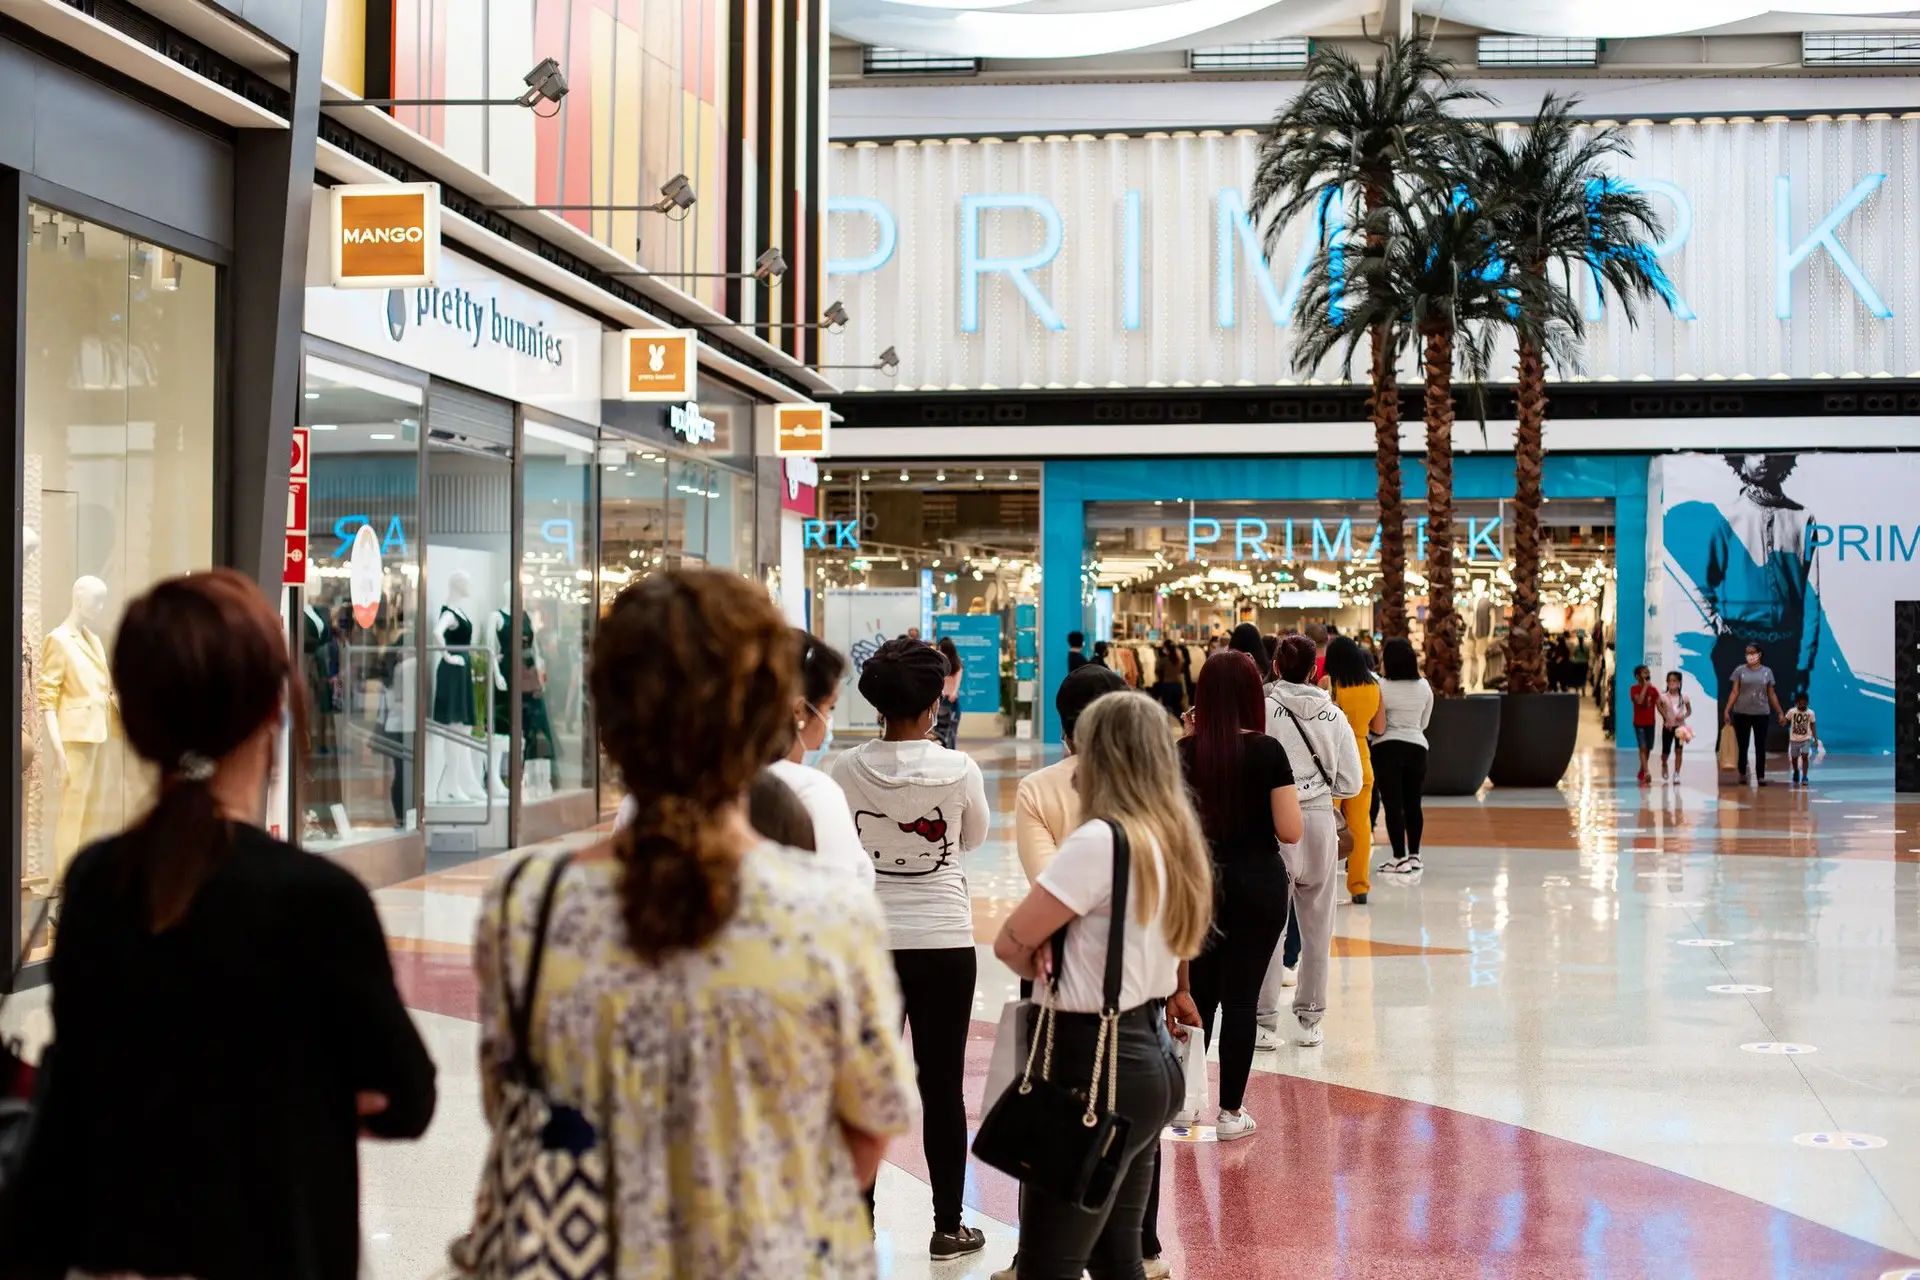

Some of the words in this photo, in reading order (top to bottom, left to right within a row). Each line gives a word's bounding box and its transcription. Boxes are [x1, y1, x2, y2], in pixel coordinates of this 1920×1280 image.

[343, 226, 423, 244] MANGO
[416, 287, 483, 347] pretty
[491, 297, 562, 366] bunnies
